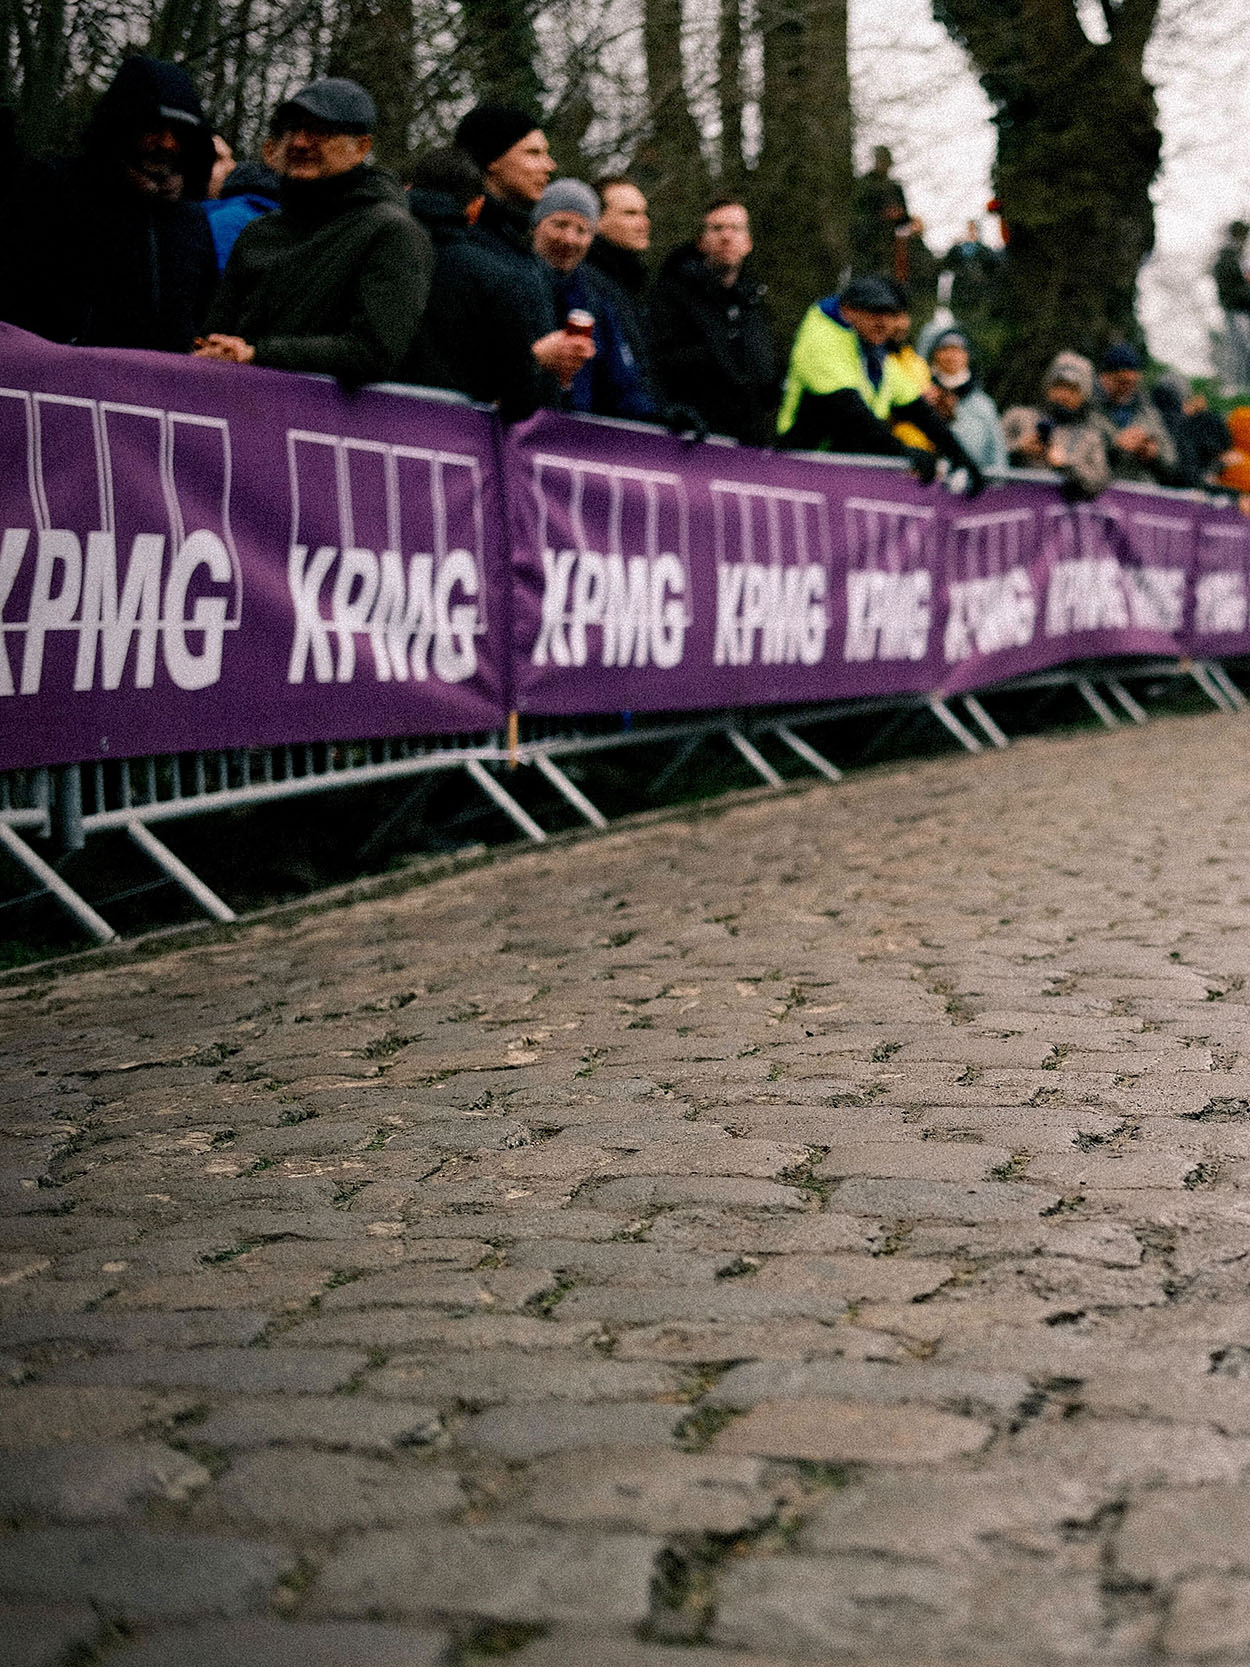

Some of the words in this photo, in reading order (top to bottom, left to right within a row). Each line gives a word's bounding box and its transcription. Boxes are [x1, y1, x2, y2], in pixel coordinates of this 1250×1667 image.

[287, 545, 480, 683] KPMG
[533, 549, 685, 668] KPMG
[713, 562, 827, 667] KPMG
